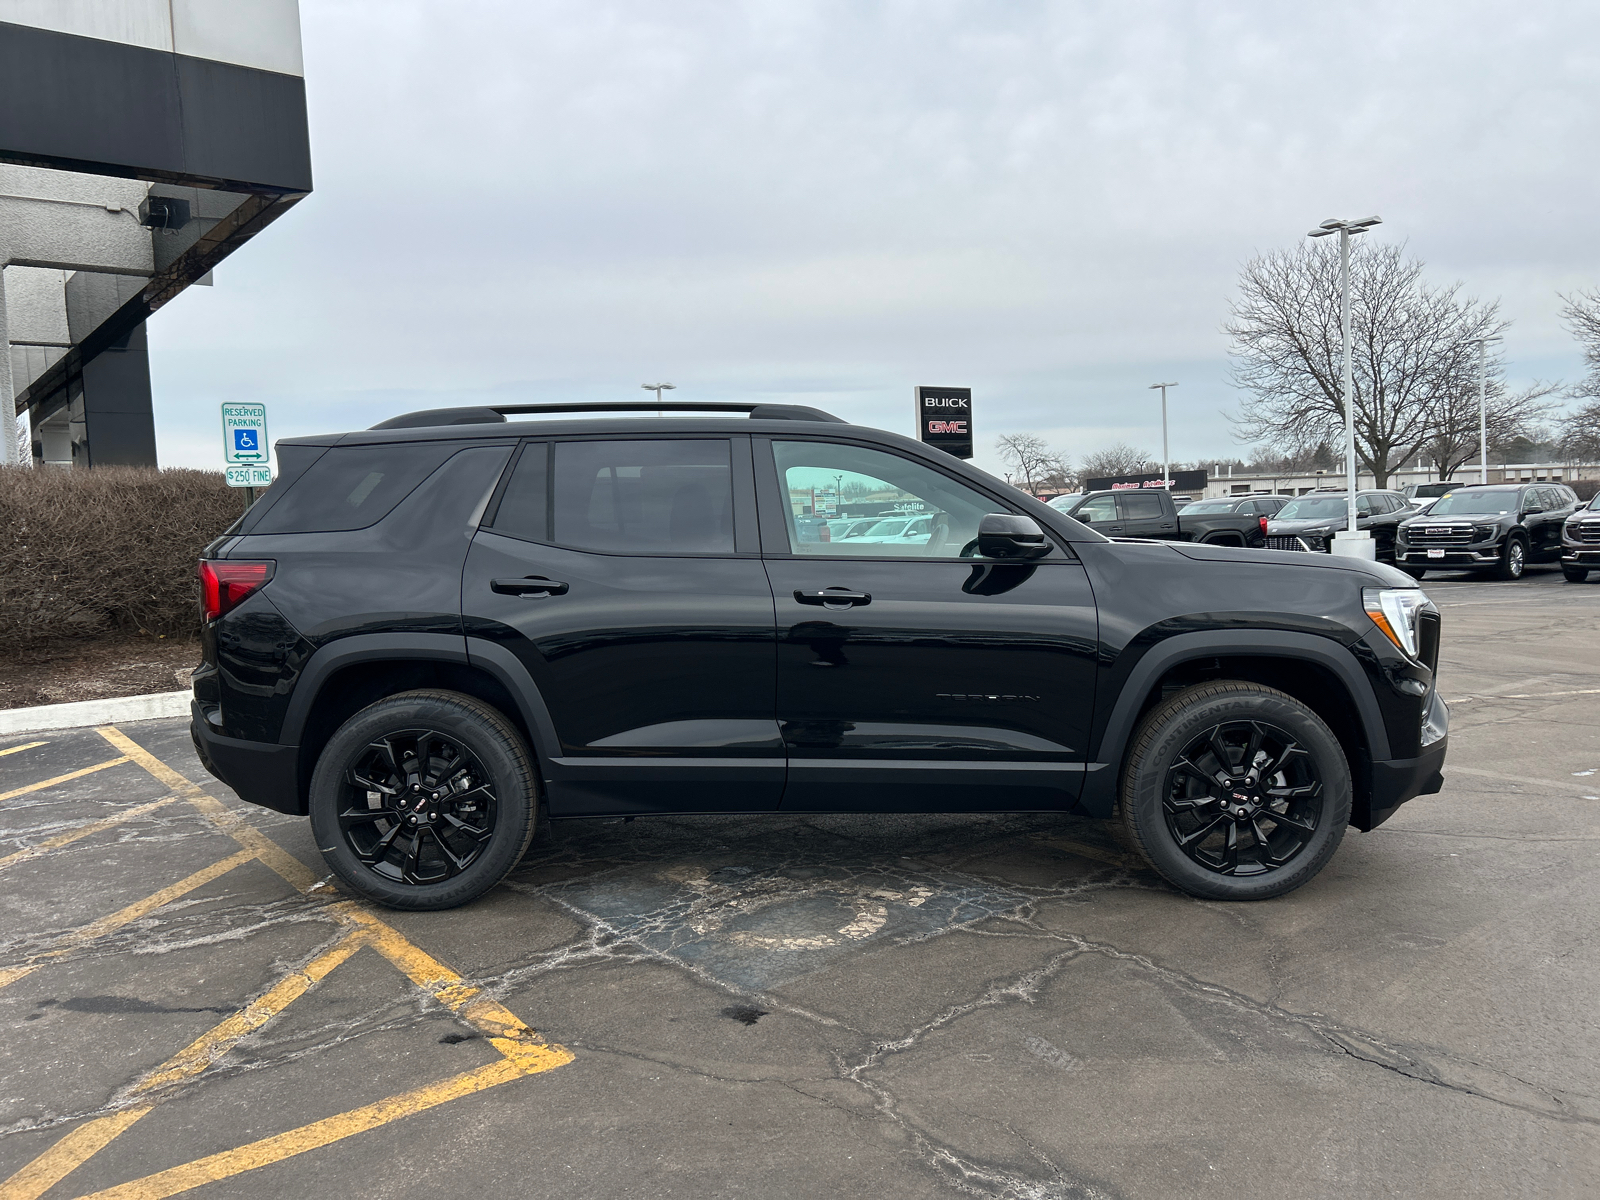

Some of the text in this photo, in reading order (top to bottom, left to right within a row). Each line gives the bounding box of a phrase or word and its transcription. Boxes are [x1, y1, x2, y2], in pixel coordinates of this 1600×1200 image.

[925, 397, 968, 407] BUICK
[224, 408, 263, 416] RESERVED
[929, 421, 967, 433] GMC
[253, 471, 269, 481] FINE
[894, 502, 924, 510] Safelite
[1152, 700, 1255, 767] CONTINENTAL
